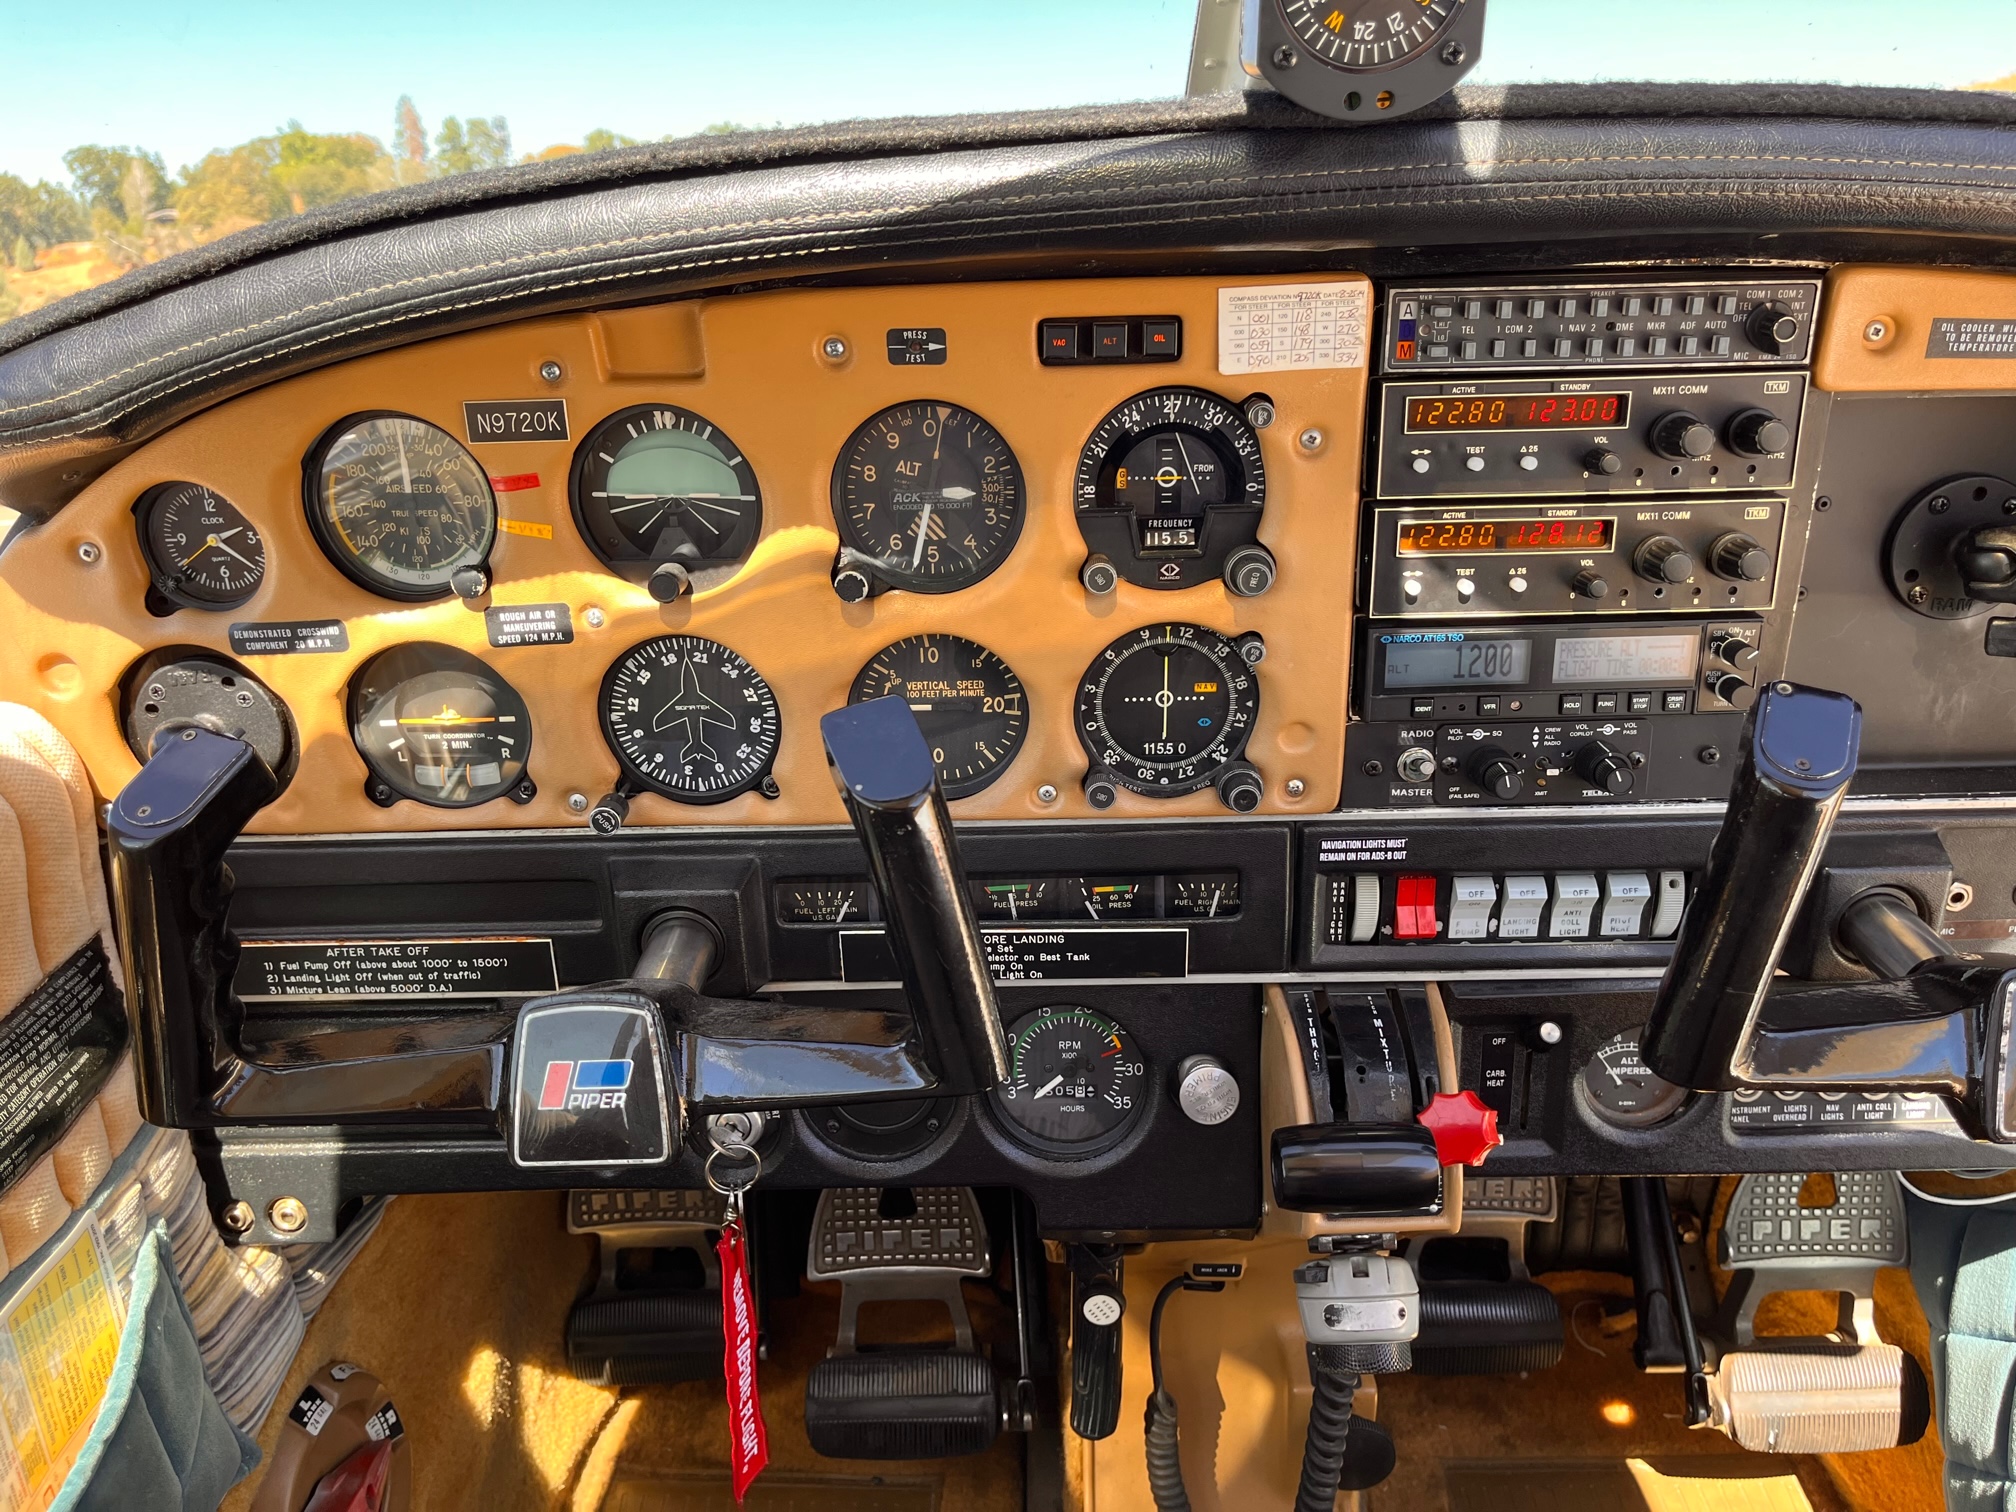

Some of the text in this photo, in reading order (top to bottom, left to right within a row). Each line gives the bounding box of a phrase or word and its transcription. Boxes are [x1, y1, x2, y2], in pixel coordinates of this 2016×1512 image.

[1386, 11, 1404, 34] 21
[1353, 21, 1376, 41] 24
[1746, 290, 1765, 299] COM
[1778, 290, 1796, 299] COM
[1403, 303, 1413, 317] A
[1791, 302, 1805, 310] INT
[1295, 308, 1313, 322] 118
[1461, 326, 1475, 334] TEL
[1505, 325, 1524, 334] COM
[1568, 324, 1586, 333] NAV
[1615, 323, 1634, 331] DME
[1647, 322, 1666, 330] MKR
[1680, 321, 1697, 330] ADF
[1704, 321, 1727, 329] AUTO
[1941, 323, 1995, 332] OIL COOLER
[903, 330, 927, 340] PRESS
[1153, 334, 1166, 343] OIL
[1945, 333, 1970, 342] TO BE
[1052, 338, 1066, 347] VAC
[1103, 336, 1117, 345] ALT
[1399, 344, 1412, 358] M
[1948, 343, 2014, 352] TEMPERATURE
[905, 353, 926, 363] TEST
[1733, 352, 1749, 361] MIC
[1452, 383, 1591, 394] ACTIVE STANDBY
[1653, 383, 1787, 395] MX11 COMM TKM
[1164, 401, 1181, 413] 27
[1416, 398, 1618, 425] 122.80 123.00
[477, 411, 561, 434] N9720K
[1466, 446, 1485, 454] TEST
[895, 459, 922, 477] ALT
[1194, 465, 1214, 473] FROM
[464, 495, 481, 507] 80
[893, 493, 920, 503] ACK
[1547, 509, 1577, 517] STANDBY
[1637, 509, 1766, 520] MX11 COMM TKM
[1149, 519, 1192, 527] FREQUENCY
[1407, 521, 1604, 547] 122.80 128.12
[499, 610, 556, 622] ROUGH AIR OR
[503, 621, 556, 632] MANEUVERING
[234, 626, 340, 639] DEMONSTRATED CROSSWIND
[498, 634, 521, 644] SPEED
[524, 633, 538, 642] 124
[1393, 633, 1464, 643] NARCO AT165 TSO
[246, 641, 288, 650] COMPONENT
[295, 640, 305, 649] 20
[920, 648, 939, 663] 10
[1453, 643, 1513, 679] 1200
[1387, 664, 1410, 674] ALT
[907, 681, 984, 690] VERTICAL SPEED
[907, 690, 919, 698] 100
[959, 689, 985, 697] MINUTE
[983, 697, 1005, 712] 20
[1401, 730, 1434, 738] RADIO
[452, 741, 472, 749] MIN.
[1391, 788, 1433, 796] MASTER
[1322, 839, 1406, 849] NAVIGATION LIGHTS MUST
[1320, 851, 1407, 861] REMAIN ON FOR ADS-B OUT
[1468, 890, 1485, 898] OFF
[1014, 935, 1065, 944] LANDING
[327, 946, 429, 957] AFTER TAKE OFF
[997, 945, 1014, 953] Set
[1040, 953, 1061, 961] Best
[1066, 953, 1090, 961] Tank
[264, 962, 273, 970] 1)
[280, 962, 299, 970] Fuel
[304, 961, 329, 971] Pump
[333, 961, 351, 969] Off
[356, 961, 387, 969] (above
[392, 960, 417, 968] about
[283, 973, 350, 983] Landing Light
[1058, 1041, 1081, 1050] RPM
[1620, 1056, 1638, 1066] ALT
[1125, 1064, 1144, 1075] 30
[1486, 1070, 1507, 1078] CARB.
[8, 1085, 31, 1112] CATEGORY
[30, 1059, 58, 1088] OPERATION
[1486, 1079, 1505, 1087] HEAT
[568, 1092, 627, 1109] PIPER
[1114, 1097, 1132, 1109] 35
[1784, 1105, 1807, 1113] LIGHTS
[1773, 1113, 1807, 1121] OVERHEAD
[1821, 1112, 1844, 1120] LIGHTS
[1752, 1219, 1881, 1240] PIPER
[835, 1228, 961, 1252] PIPER
[740, 1399, 758, 1463] FLIGHT
